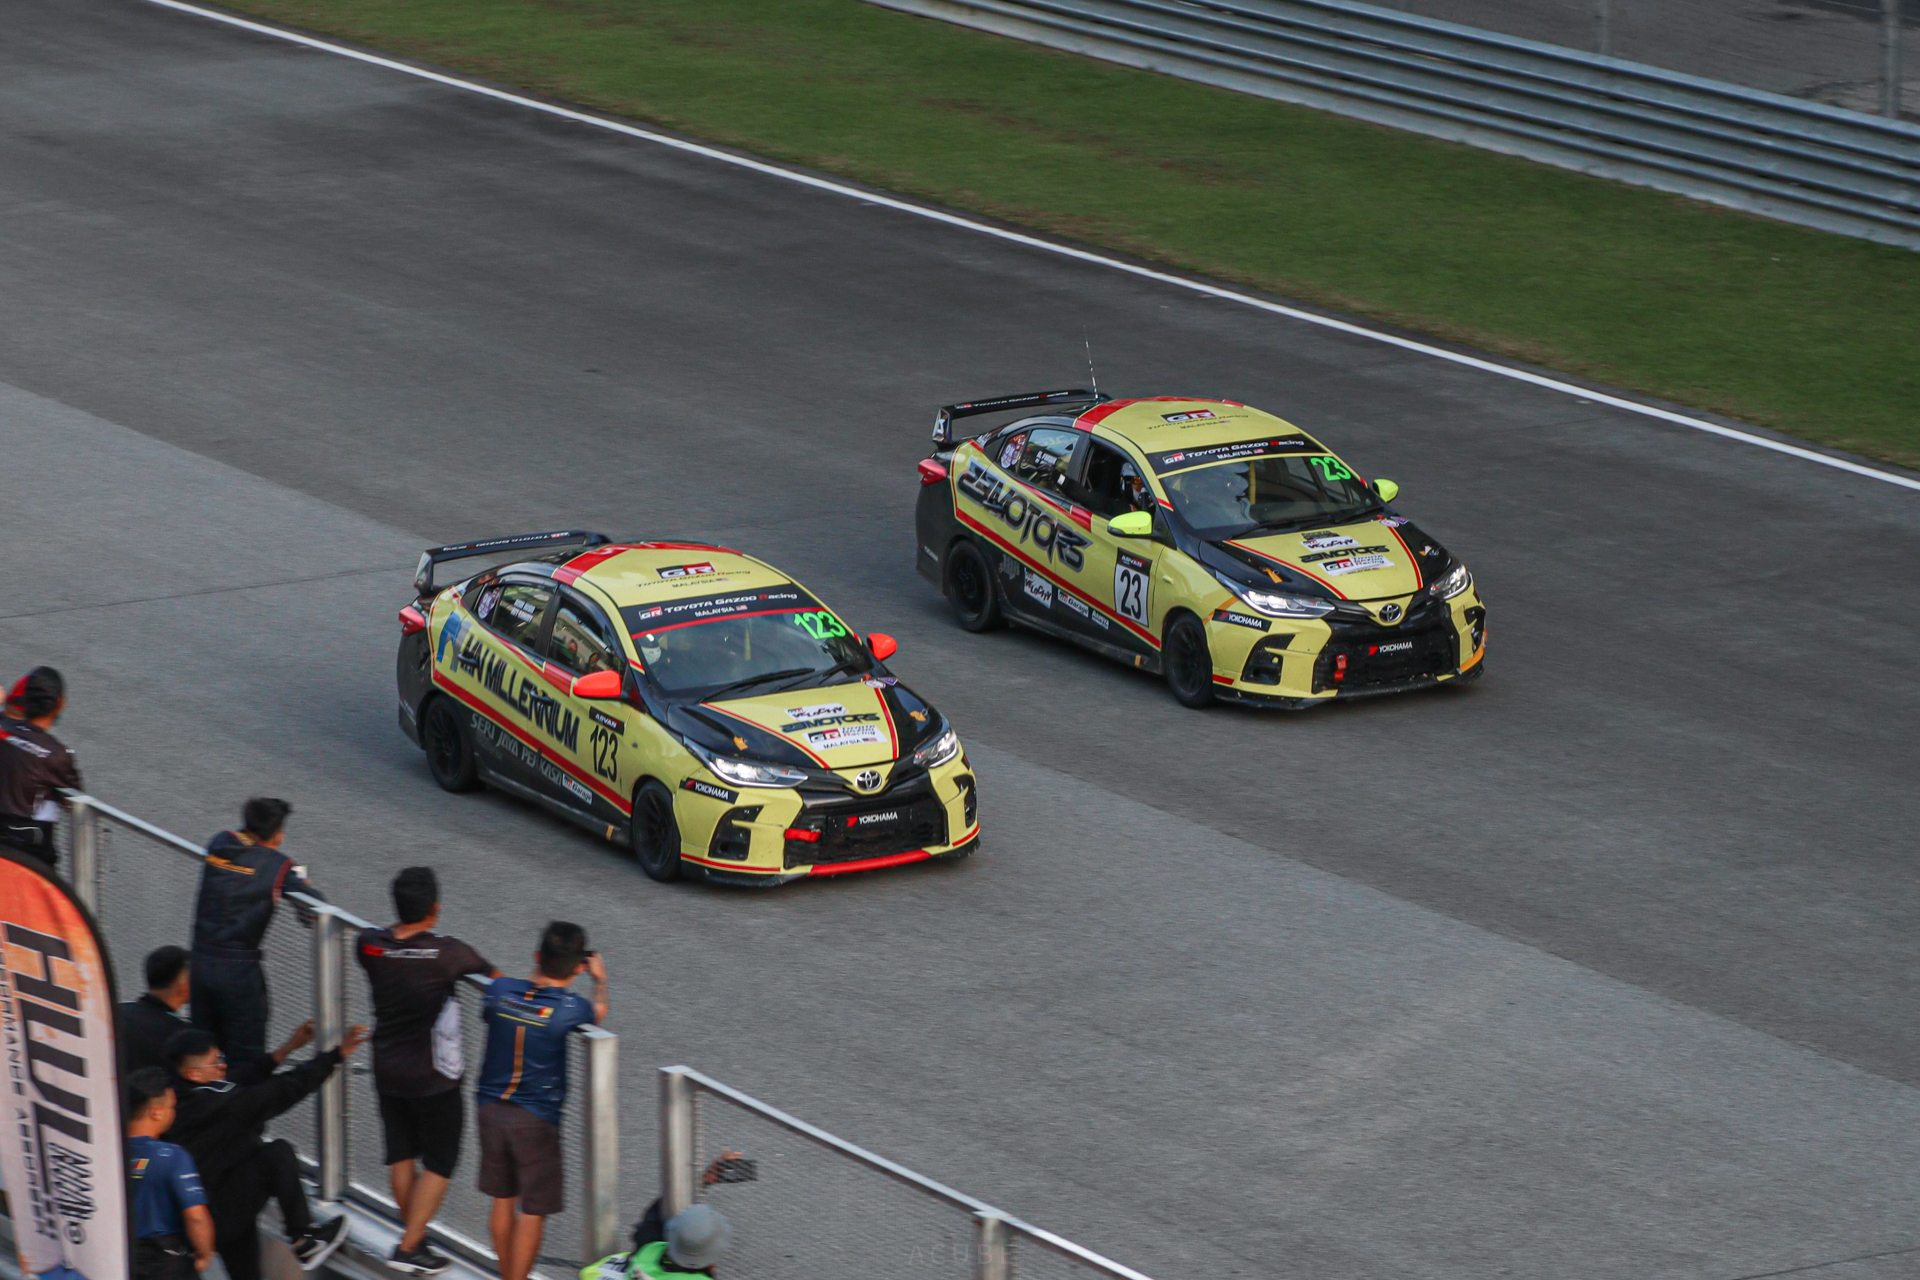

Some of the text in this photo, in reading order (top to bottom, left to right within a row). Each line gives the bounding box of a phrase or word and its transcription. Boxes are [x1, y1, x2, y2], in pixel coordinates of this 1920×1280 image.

[1160, 409, 1217, 424] GR
[1147, 421, 1183, 430] TOYOTA
[1180, 421, 1218, 430] MALAYSIA
[1162, 439, 1305, 465] GR TOYOTA GAZOO Racing
[1216, 450, 1253, 460] MALAYSIA
[1310, 456, 1352, 482] 23
[1121, 555, 1143, 568] ADVAN
[1322, 558, 1354, 571] GR
[655, 561, 718, 579] GR
[636, 577, 677, 588] TOYOTA
[679, 573, 716, 581] GAZOO
[671, 579, 716, 588] MALAYSIA
[1119, 568, 1142, 620] 23
[639, 591, 798, 620] GR TOYOTA GAZOO Racing
[694, 606, 735, 617] MALAYSIA
[1068, 598, 1089, 615] Garage
[793, 610, 848, 640] 123
[1228, 613, 1262, 629] YOKOHAMA
[1379, 641, 1413, 654] YOKOHAMA
[484, 652, 581, 755] MILLENNIUM
[595, 712, 617, 729] ADVAN
[470, 712, 496, 740] SERI
[496, 730, 519, 757] JAYA
[808, 728, 841, 743] GR
[823, 739, 862, 750] MALAYSIA
[590, 725, 619, 783] 123
[573, 782, 592, 803] Garage
[694, 782, 729, 801] YOKOHAMA
[858, 811, 899, 825] YOKOHAMA
